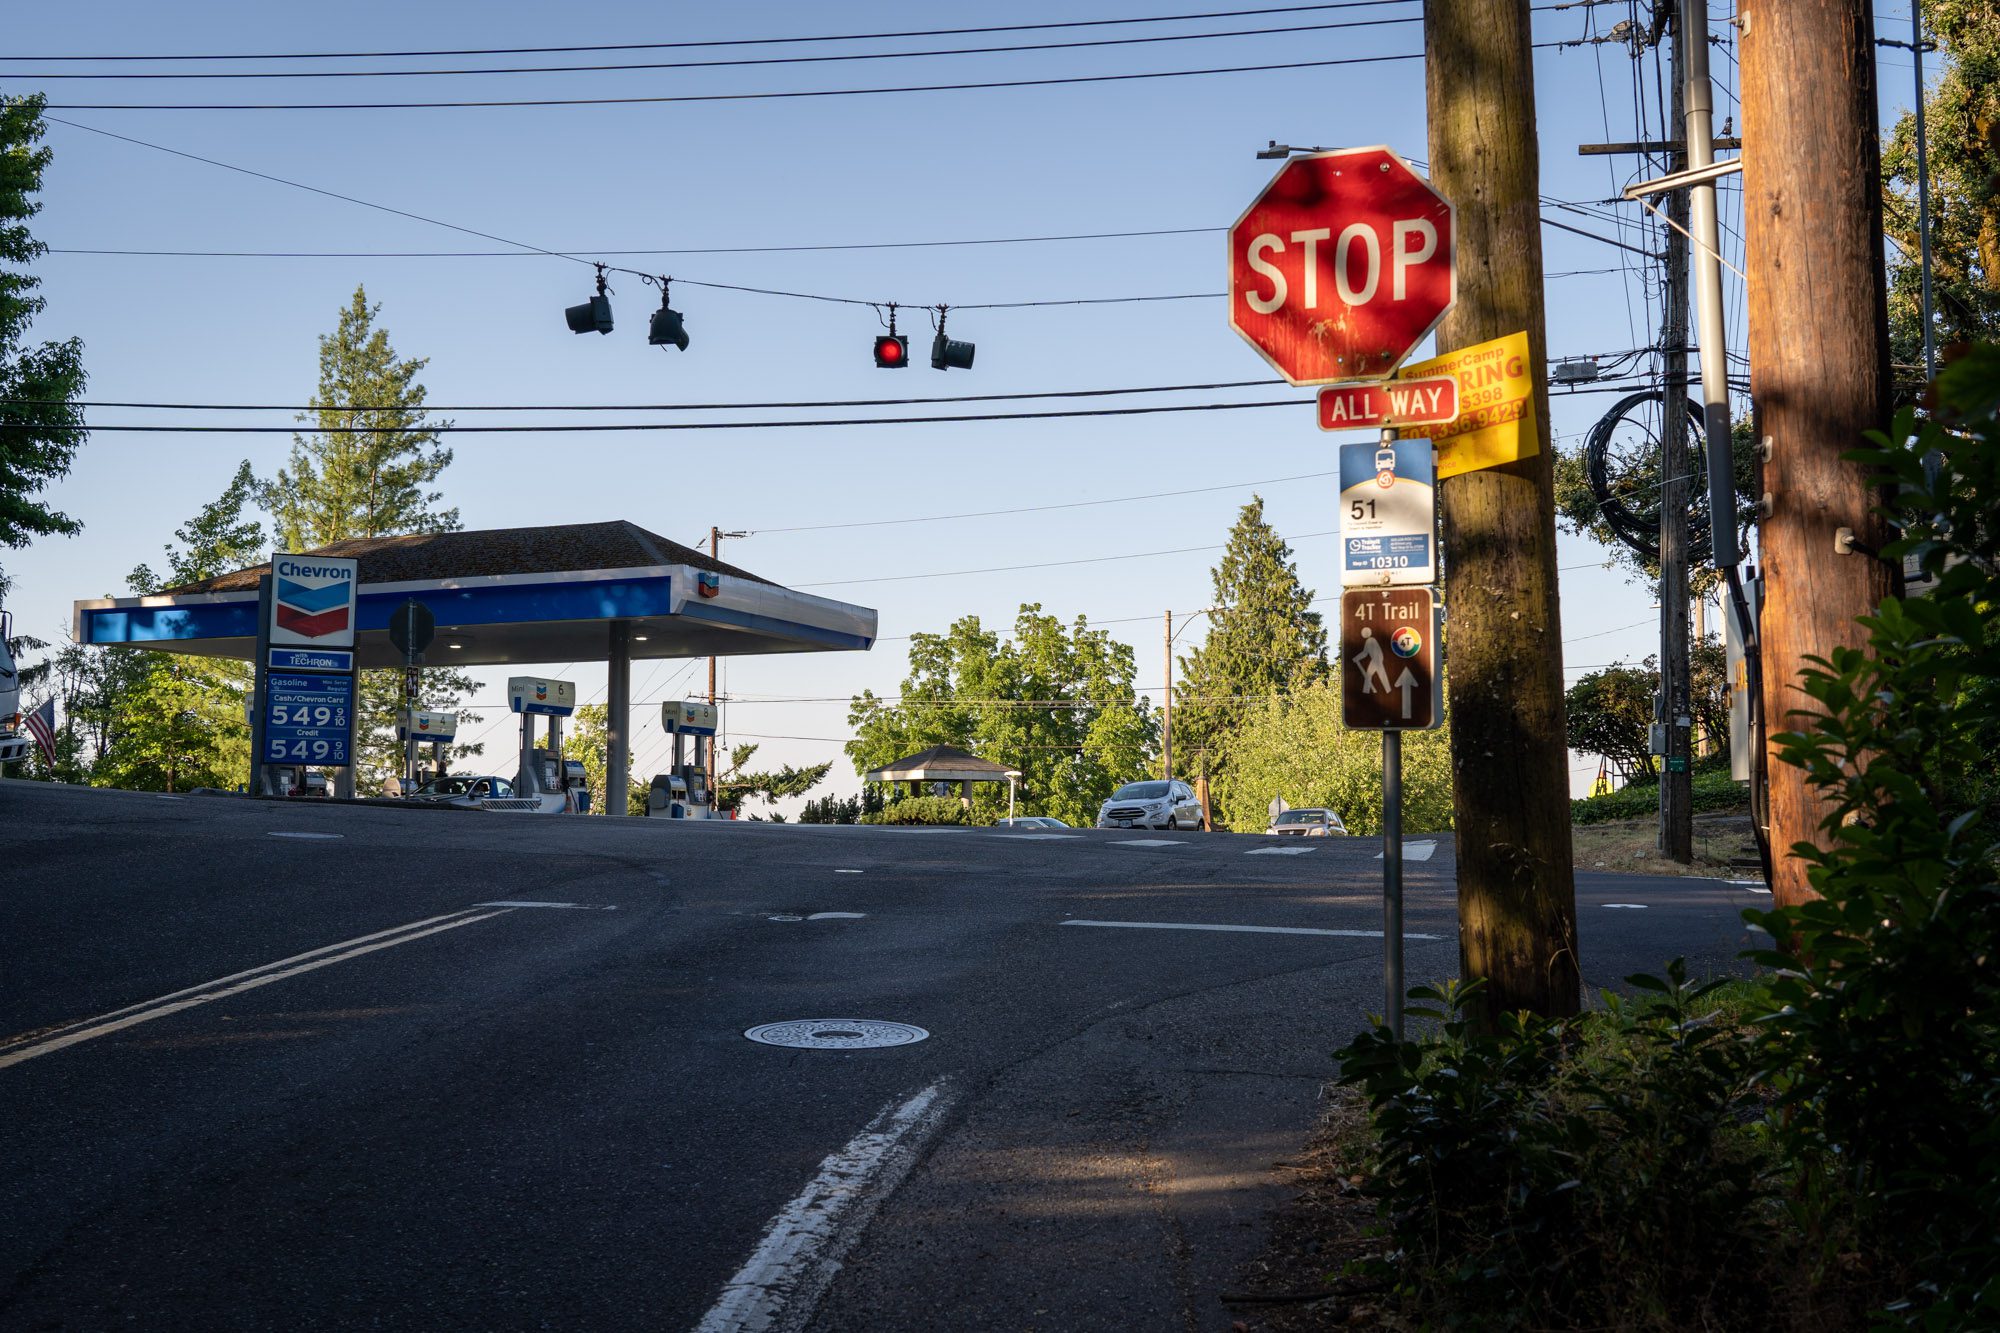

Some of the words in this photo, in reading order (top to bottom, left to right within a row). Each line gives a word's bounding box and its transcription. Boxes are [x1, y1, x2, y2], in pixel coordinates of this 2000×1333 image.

[1245, 218, 1438, 314] STOP
[1459, 356, 1523, 392] RING
[1331, 393, 1378, 421] ALL
[1390, 387, 1443, 416] WAY
[1351, 498, 1376, 520] 51
[1370, 556, 1408, 568] 10310
[278, 561, 352, 579] Chevron
[1355, 603, 1375, 621] 4T
[1382, 602, 1419, 620] Trail
[1400, 637, 1412, 648] 4T
[290, 656, 332, 667] TECHRON
[271, 678, 308, 687] Gasoline
[558, 684, 564, 696] 6
[273, 694, 326, 703] Cash/Chevron
[327, 696, 345, 704] Card
[271, 706, 331, 726] 549
[703, 708, 709, 718] 8
[440, 715, 446, 725] 4
[296, 729, 319, 737] Credit
[270, 739, 329, 759] 549
